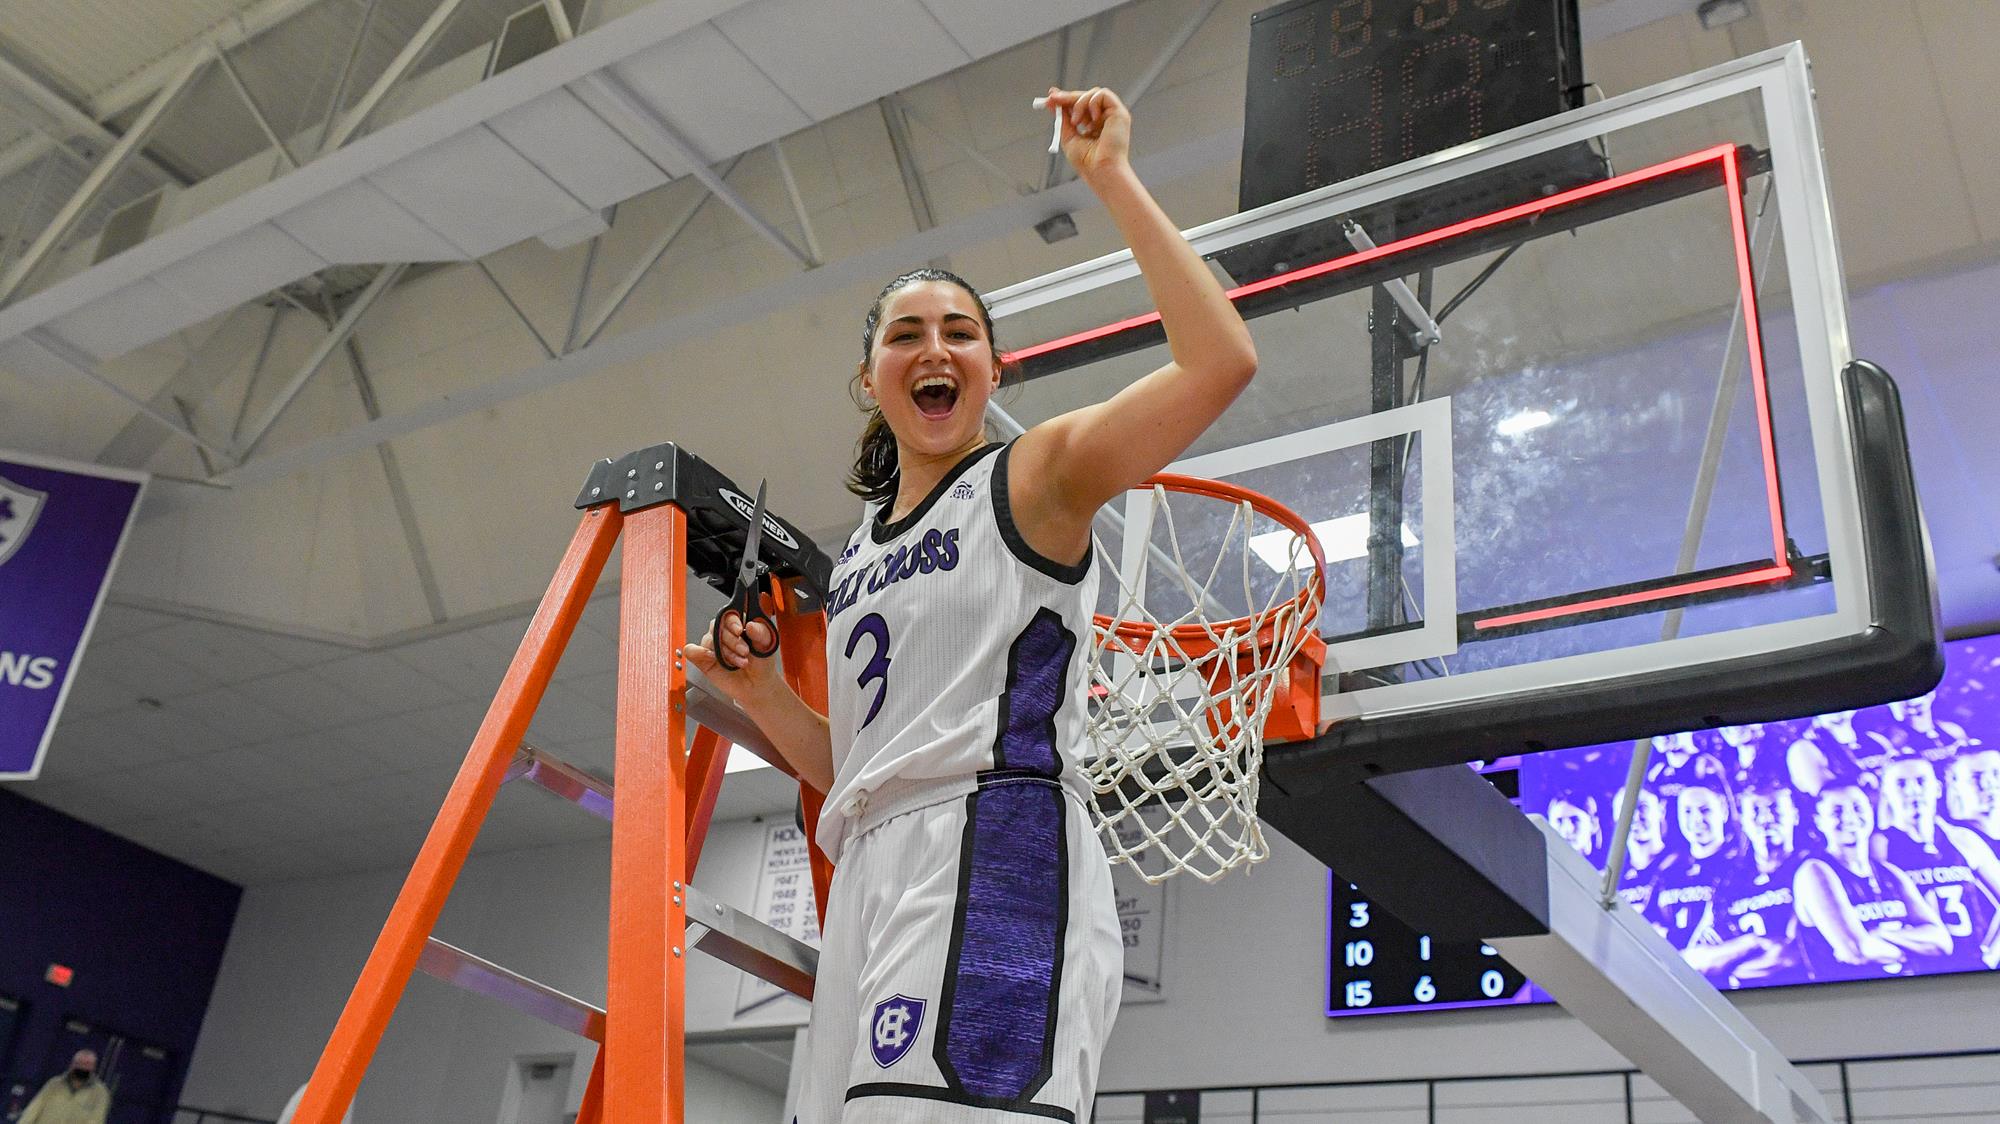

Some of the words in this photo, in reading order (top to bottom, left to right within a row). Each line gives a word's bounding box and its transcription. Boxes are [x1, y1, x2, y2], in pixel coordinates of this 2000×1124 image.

[736, 498, 785, 540] WENER
[844, 612, 892, 737] 3
[1349, 902, 1370, 928] 3
[1345, 939, 1374, 967] 10
[1419, 935, 1431, 961] 1
[1345, 980, 1373, 1007] 15
[1413, 975, 1437, 1003] 6
[1480, 969, 1505, 998] 0
